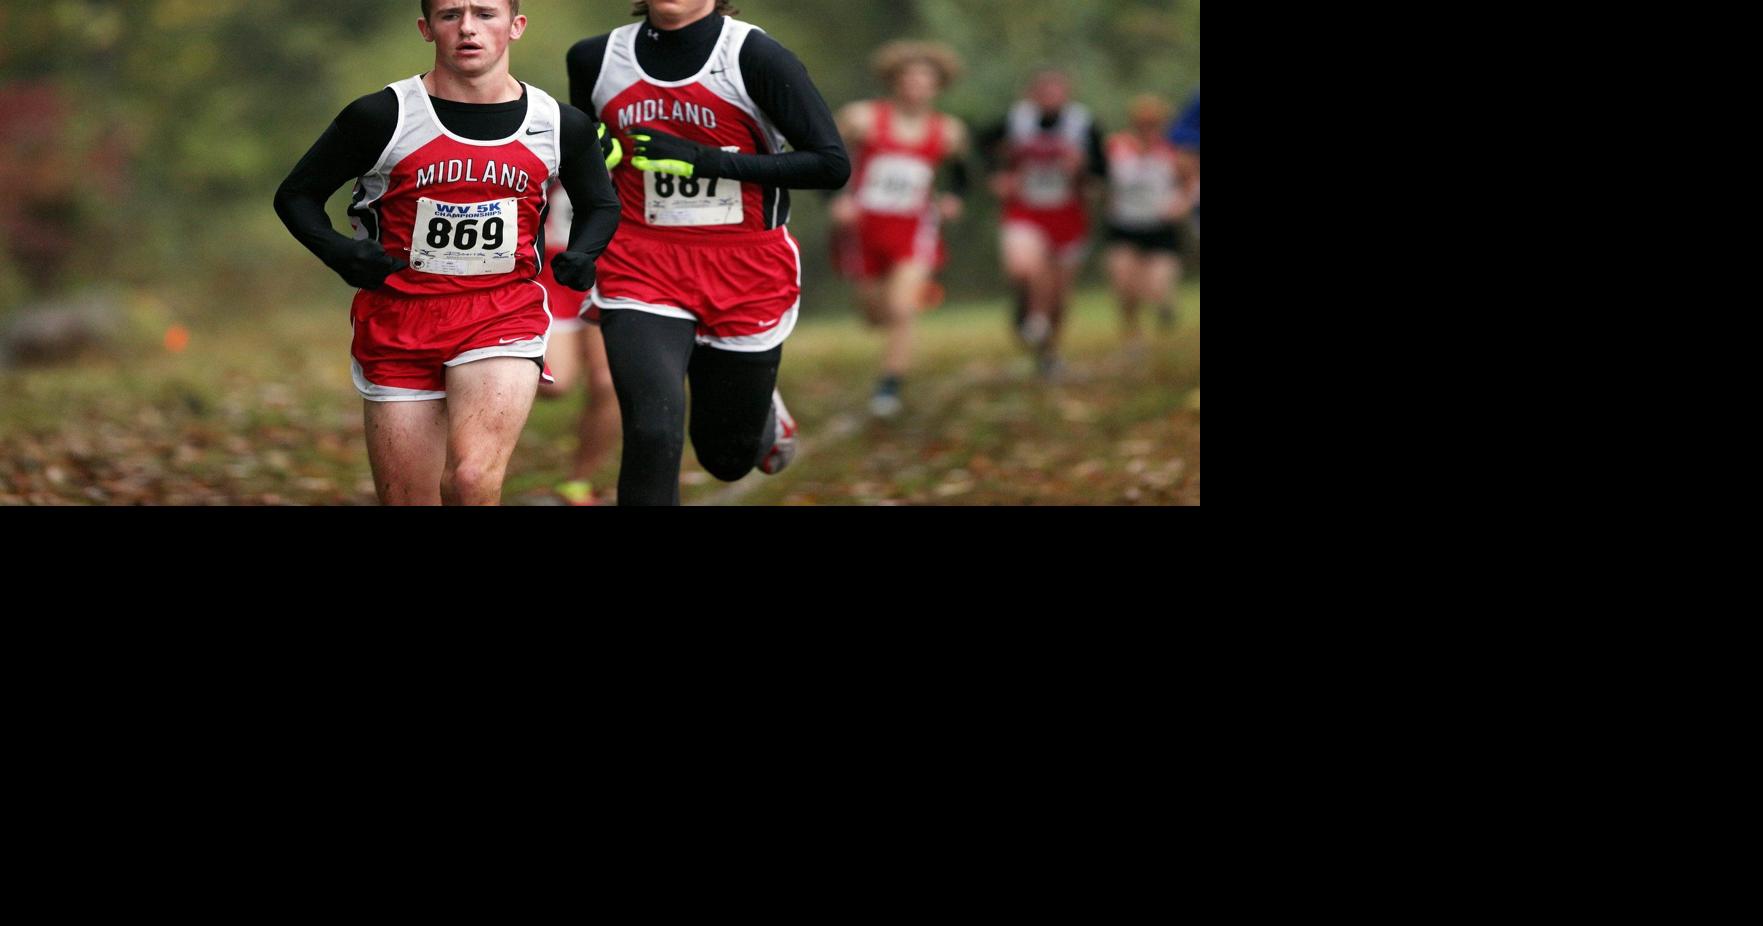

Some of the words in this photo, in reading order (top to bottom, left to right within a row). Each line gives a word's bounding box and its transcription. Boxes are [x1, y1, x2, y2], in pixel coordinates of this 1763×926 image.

[618, 99, 717, 129] MIDLAND
[416, 159, 529, 192] MIDLAND
[436, 203, 470, 214] WV
[477, 202, 501, 213] 5K
[427, 217, 504, 250] 869
